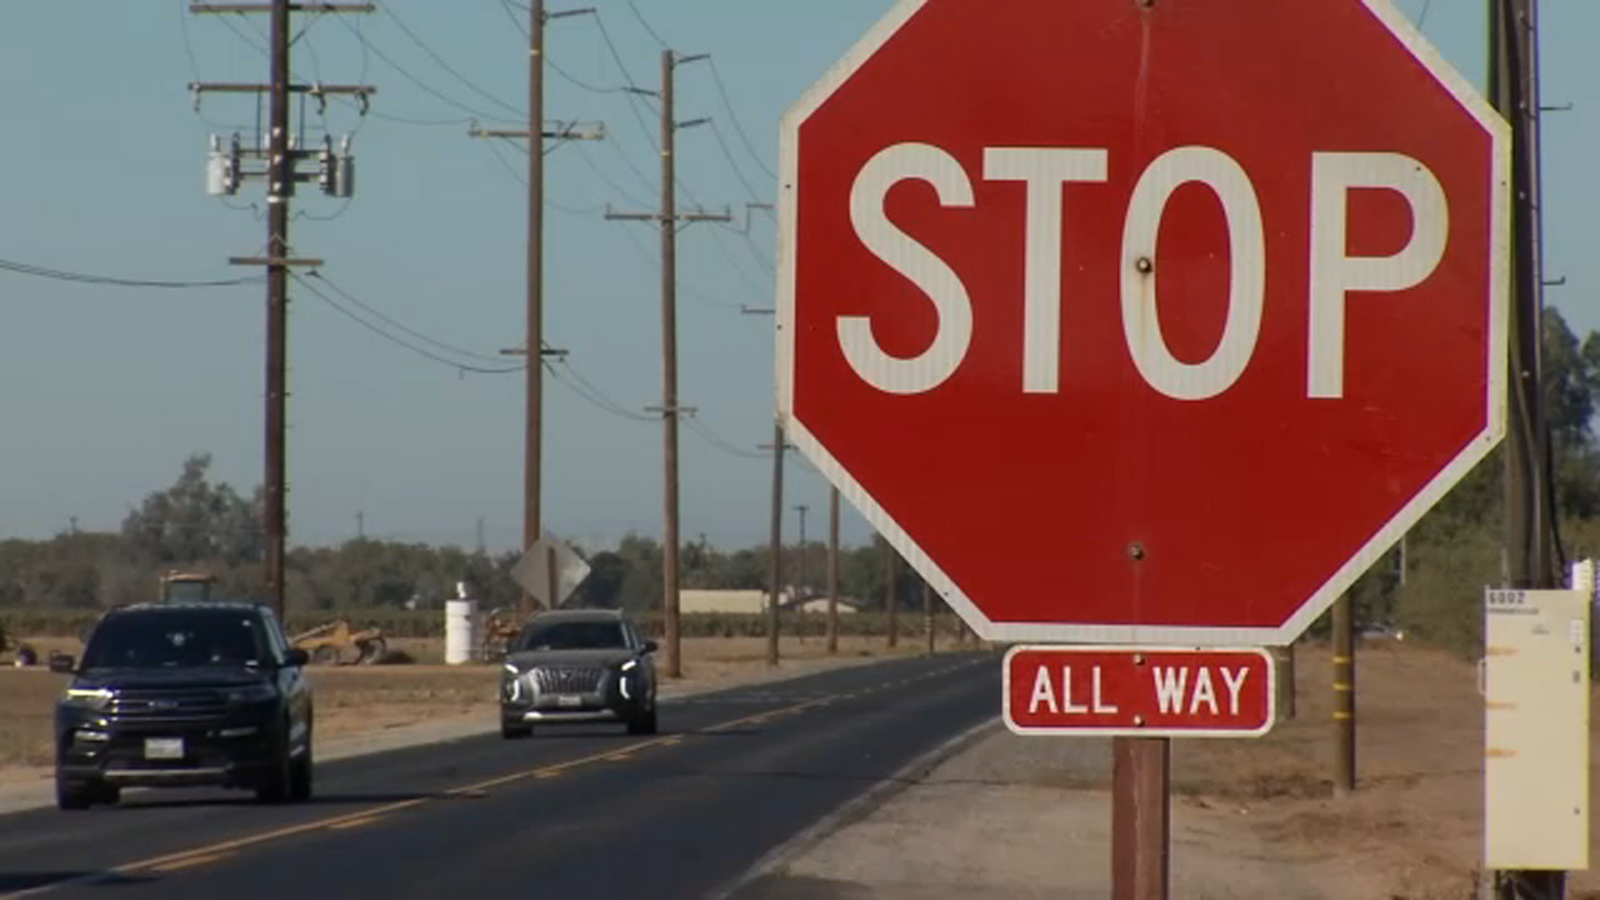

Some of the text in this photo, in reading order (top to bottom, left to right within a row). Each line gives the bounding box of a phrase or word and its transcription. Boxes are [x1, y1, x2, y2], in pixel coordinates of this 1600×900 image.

[837, 142, 1448, 400] STOP
[1028, 665, 1249, 715] ALL WAY
